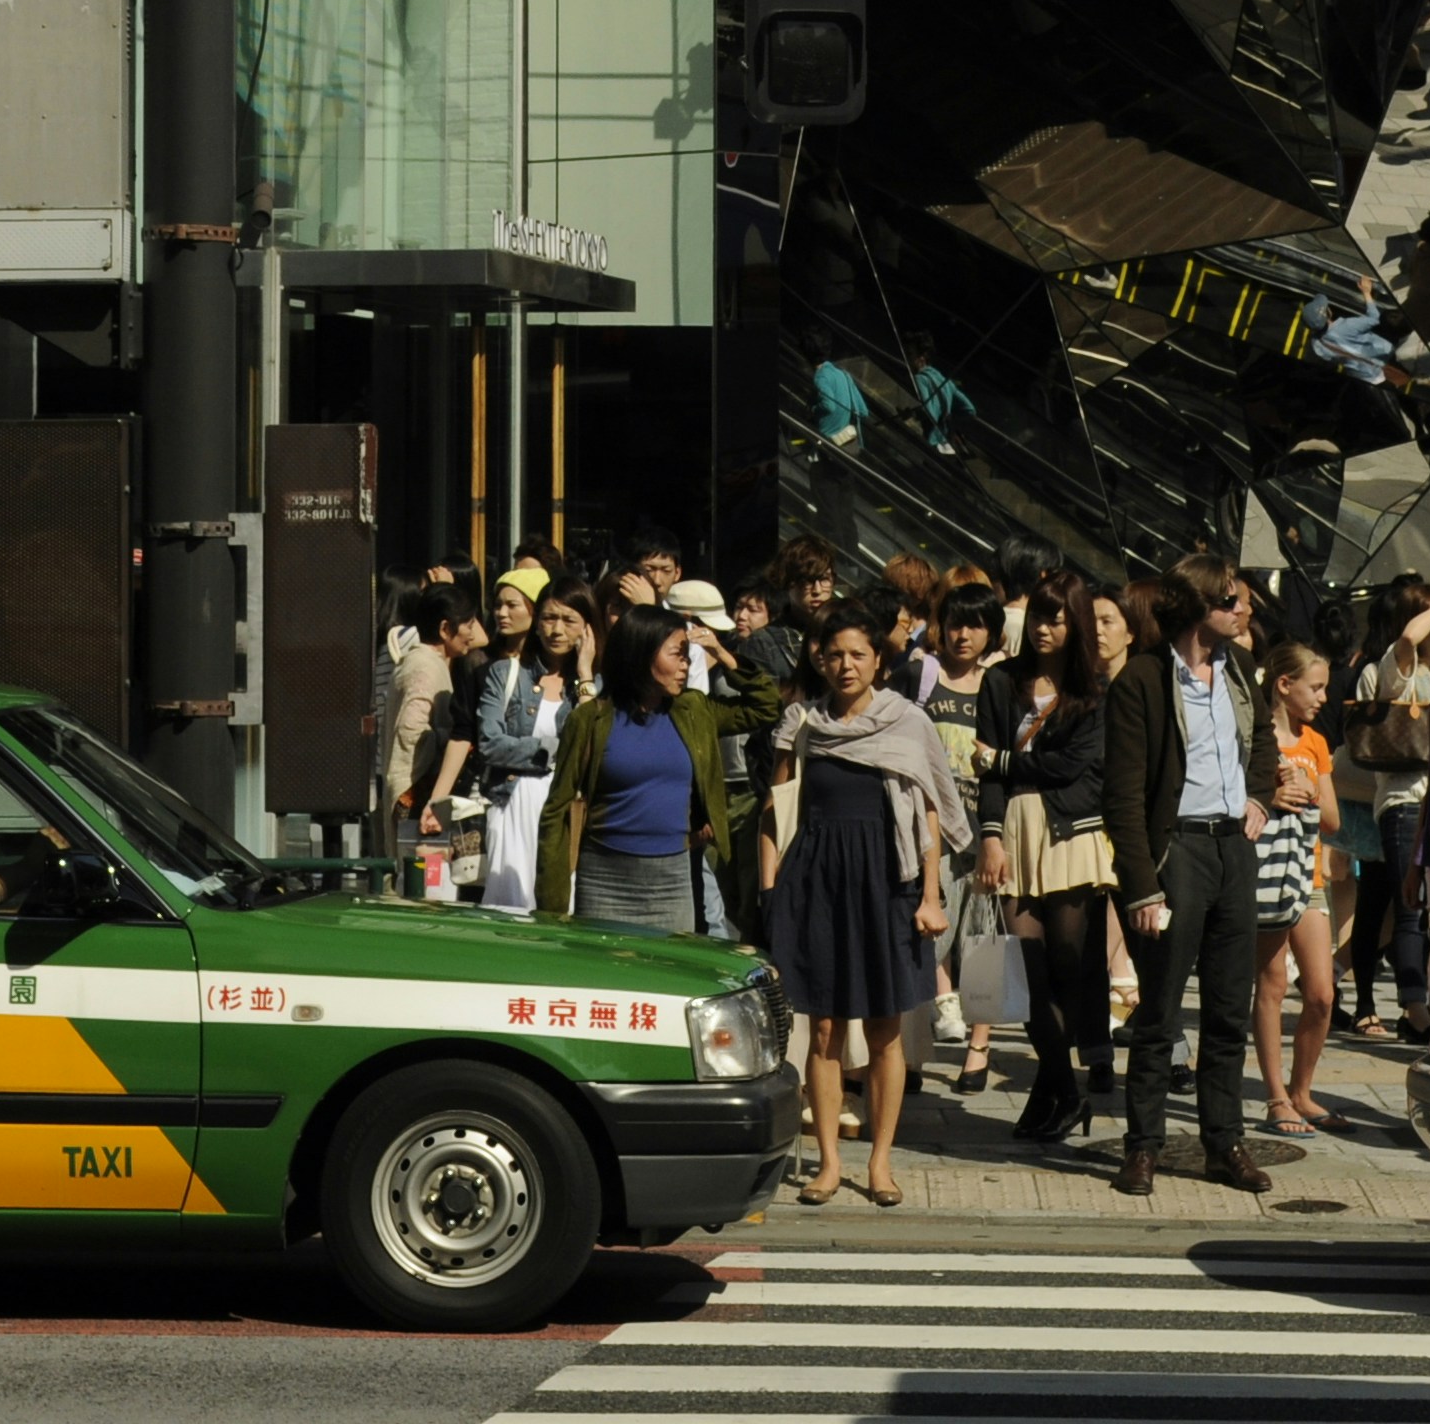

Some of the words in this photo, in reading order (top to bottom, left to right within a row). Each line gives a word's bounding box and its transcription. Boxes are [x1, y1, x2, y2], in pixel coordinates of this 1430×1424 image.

[928, 699, 957, 716] THE
[9, 975, 37, 1005] 園
[207, 985, 286, 1013] (杉並)
[508, 997, 658, 1031] 東京無線
[62, 1146, 133, 1178] TAXI
